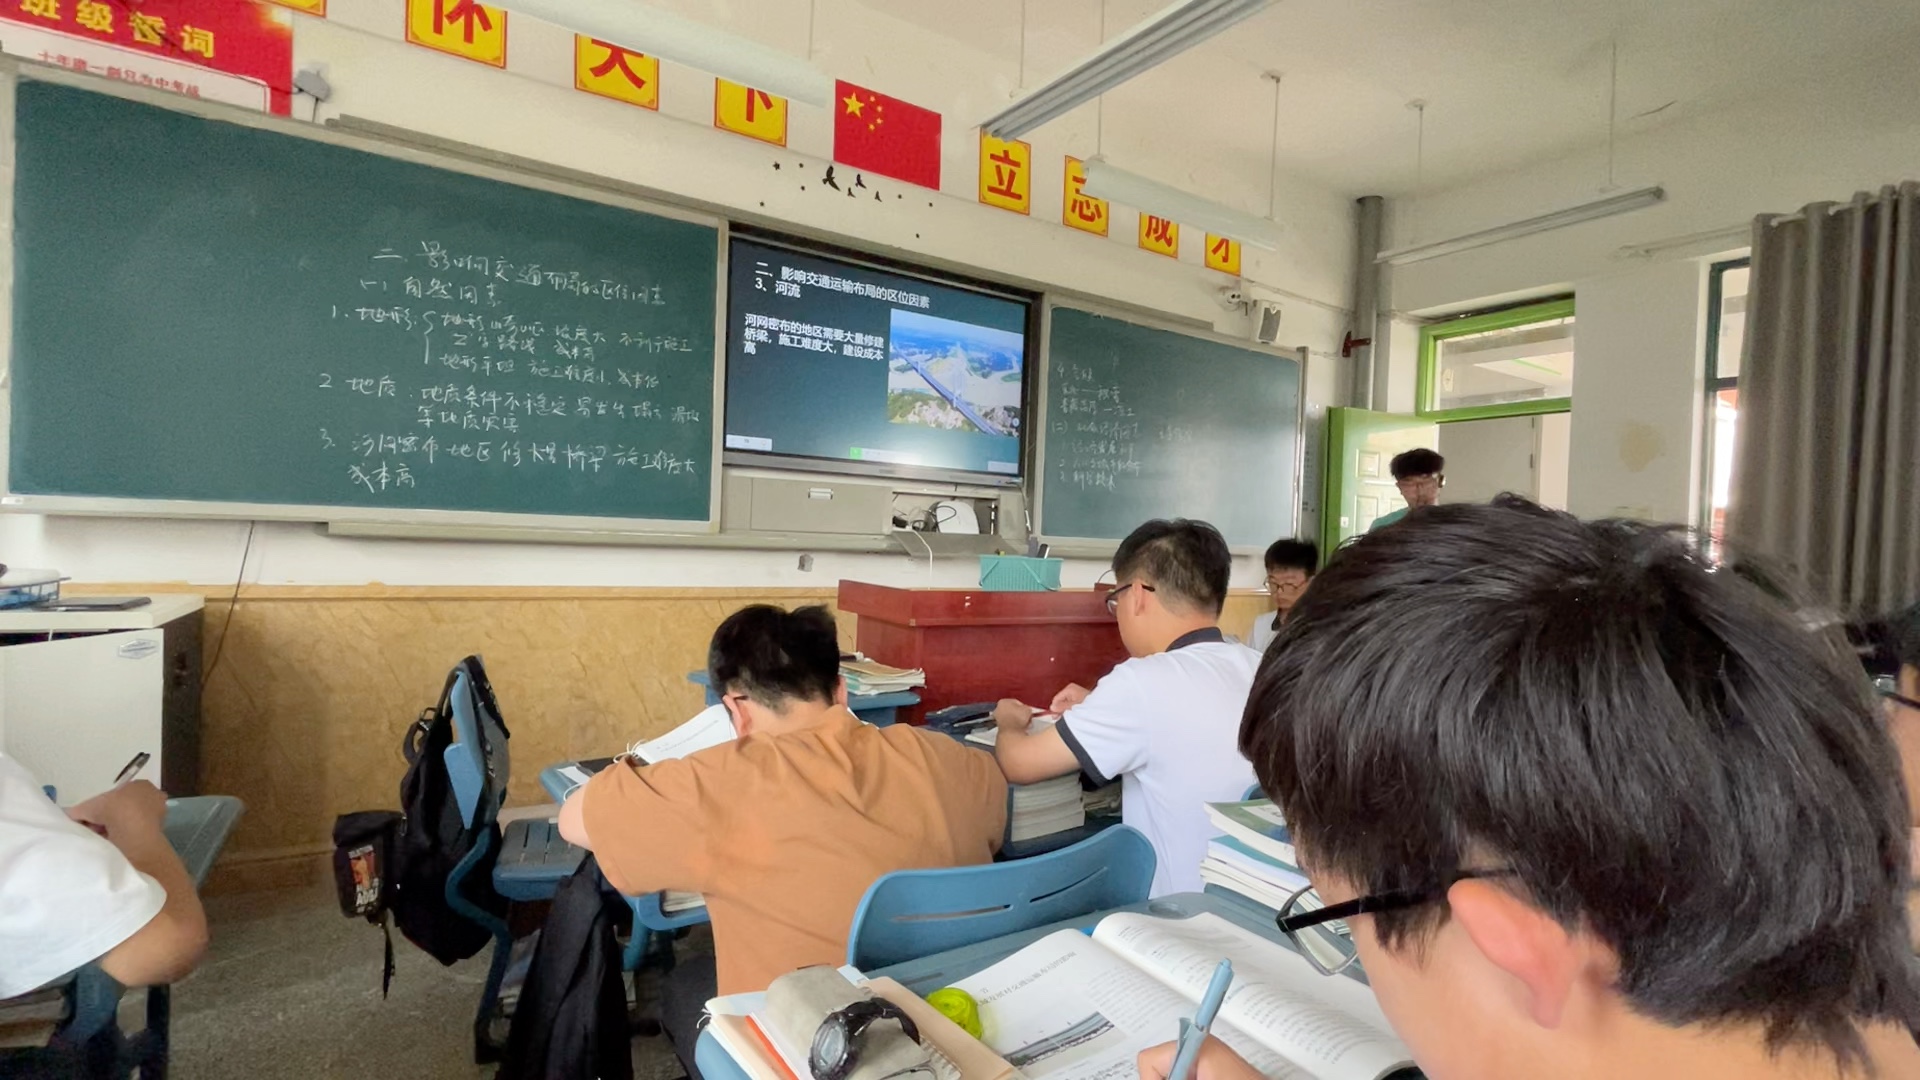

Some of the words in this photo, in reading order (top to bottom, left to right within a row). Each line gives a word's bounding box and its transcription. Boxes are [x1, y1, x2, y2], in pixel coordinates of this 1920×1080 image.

[987, 149, 1023, 200] 立
[403, 276, 500, 307] 自然因素
[755, 261, 930, 309] 二、影响交通运输布局的区位因素
[755, 277, 801, 299] 3、河流
[743, 341, 756, 355] 高
[744, 313, 884, 349] 河网密布的地区需要大量修建
[744, 327, 884, 361] 桥梁，施工难度大，建设成本
